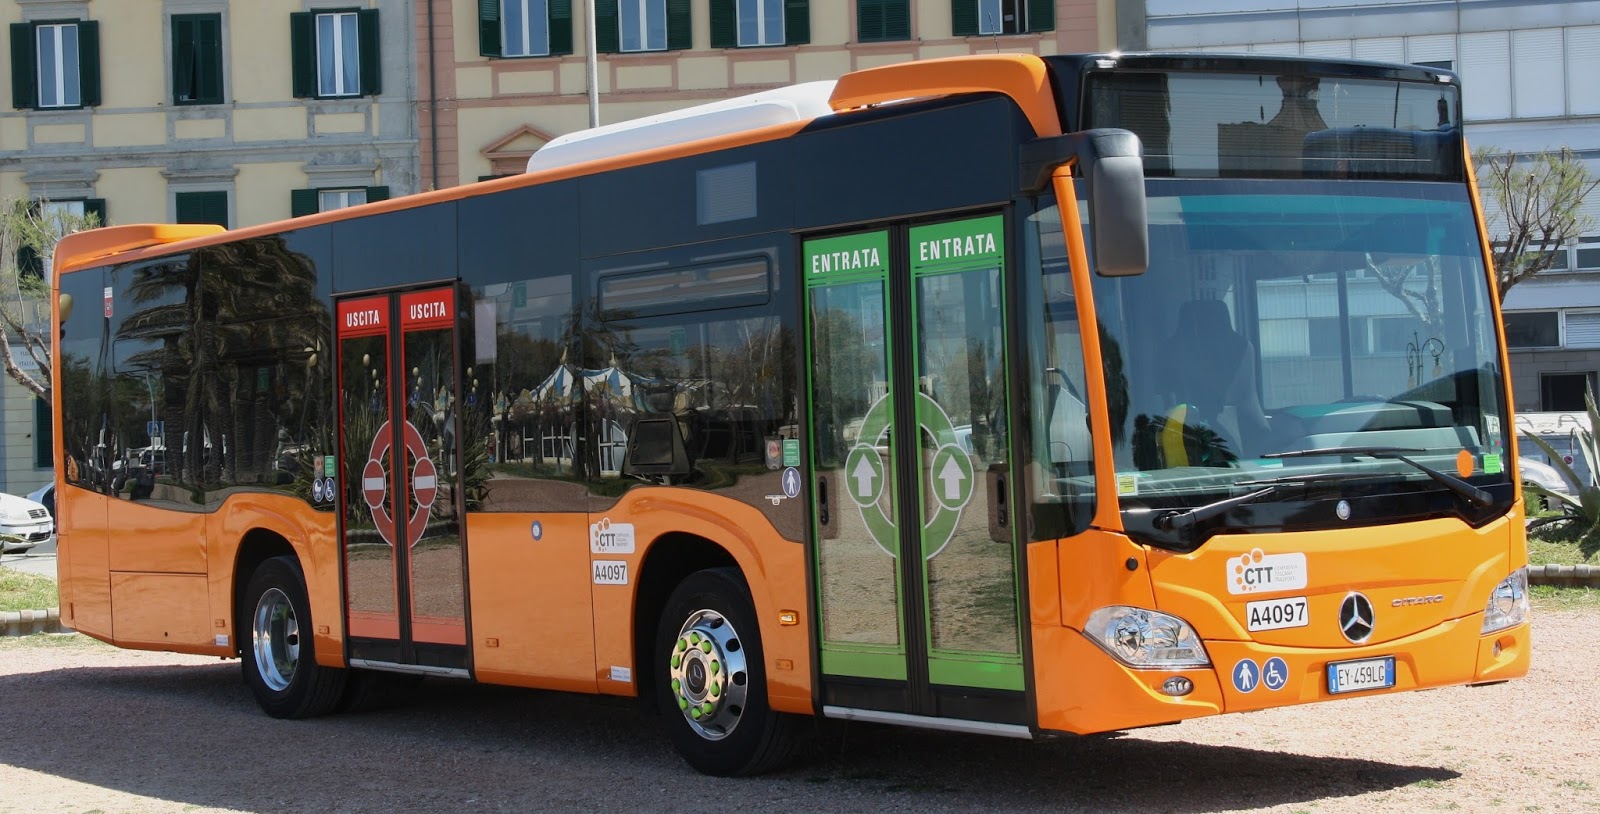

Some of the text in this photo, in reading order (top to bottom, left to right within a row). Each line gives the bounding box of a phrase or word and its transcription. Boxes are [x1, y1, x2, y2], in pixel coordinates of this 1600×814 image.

[920, 233, 996, 262] ENTRATA
[812, 247, 880, 274] ENTRATA
[346, 309, 380, 328] USCITA
[410, 301, 446, 320] USCITA
[599, 533, 616, 547] CTT
[595, 564, 626, 581] A4097
[1244, 566, 1274, 585] CTT
[1391, 594, 1444, 608] CITARO
[1250, 602, 1306, 627] A4097
